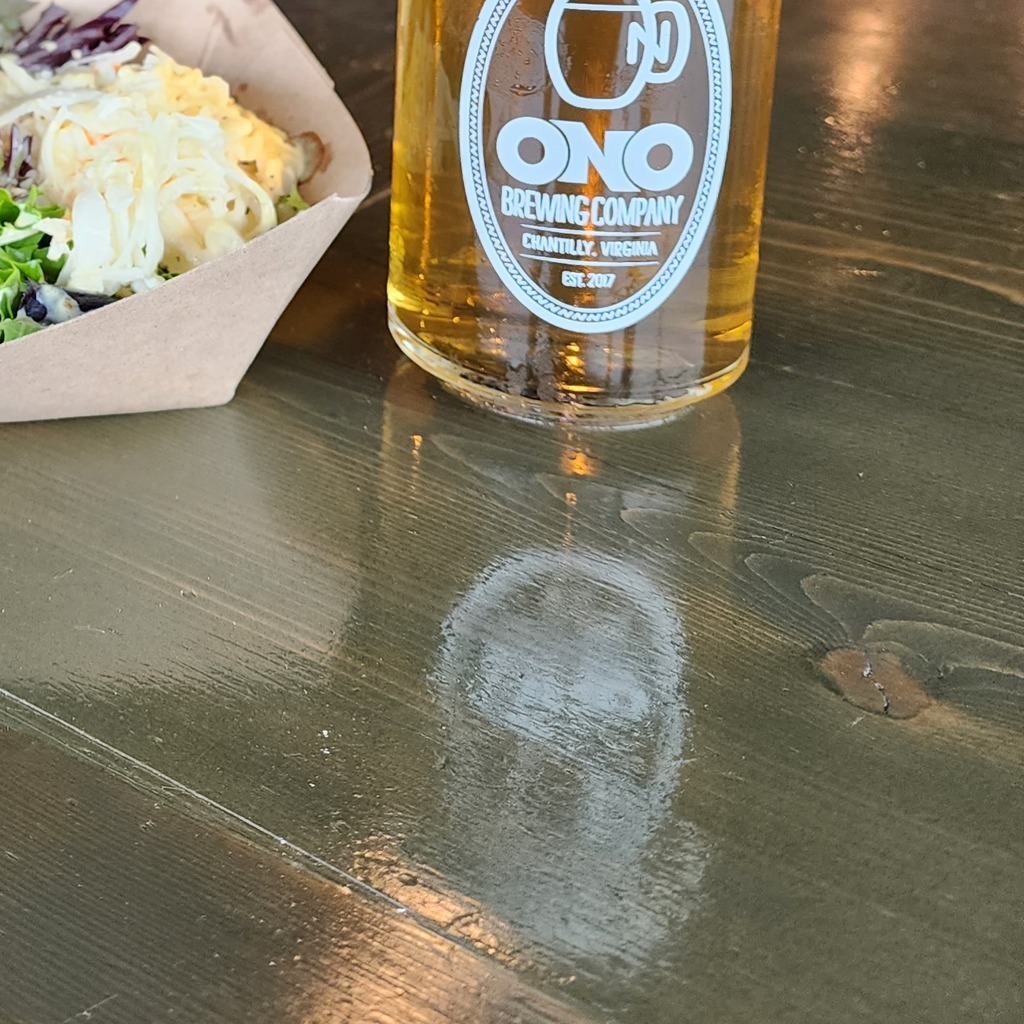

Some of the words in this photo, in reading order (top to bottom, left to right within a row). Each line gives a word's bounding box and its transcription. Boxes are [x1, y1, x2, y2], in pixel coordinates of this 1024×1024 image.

[496, 116, 694, 193] ONO
[501, 185, 590, 226] BREWING
[590, 195, 685, 227] COMPANY
[600, 240, 658, 258] VIRGINIA
[585, 272, 617, 289] 2017
